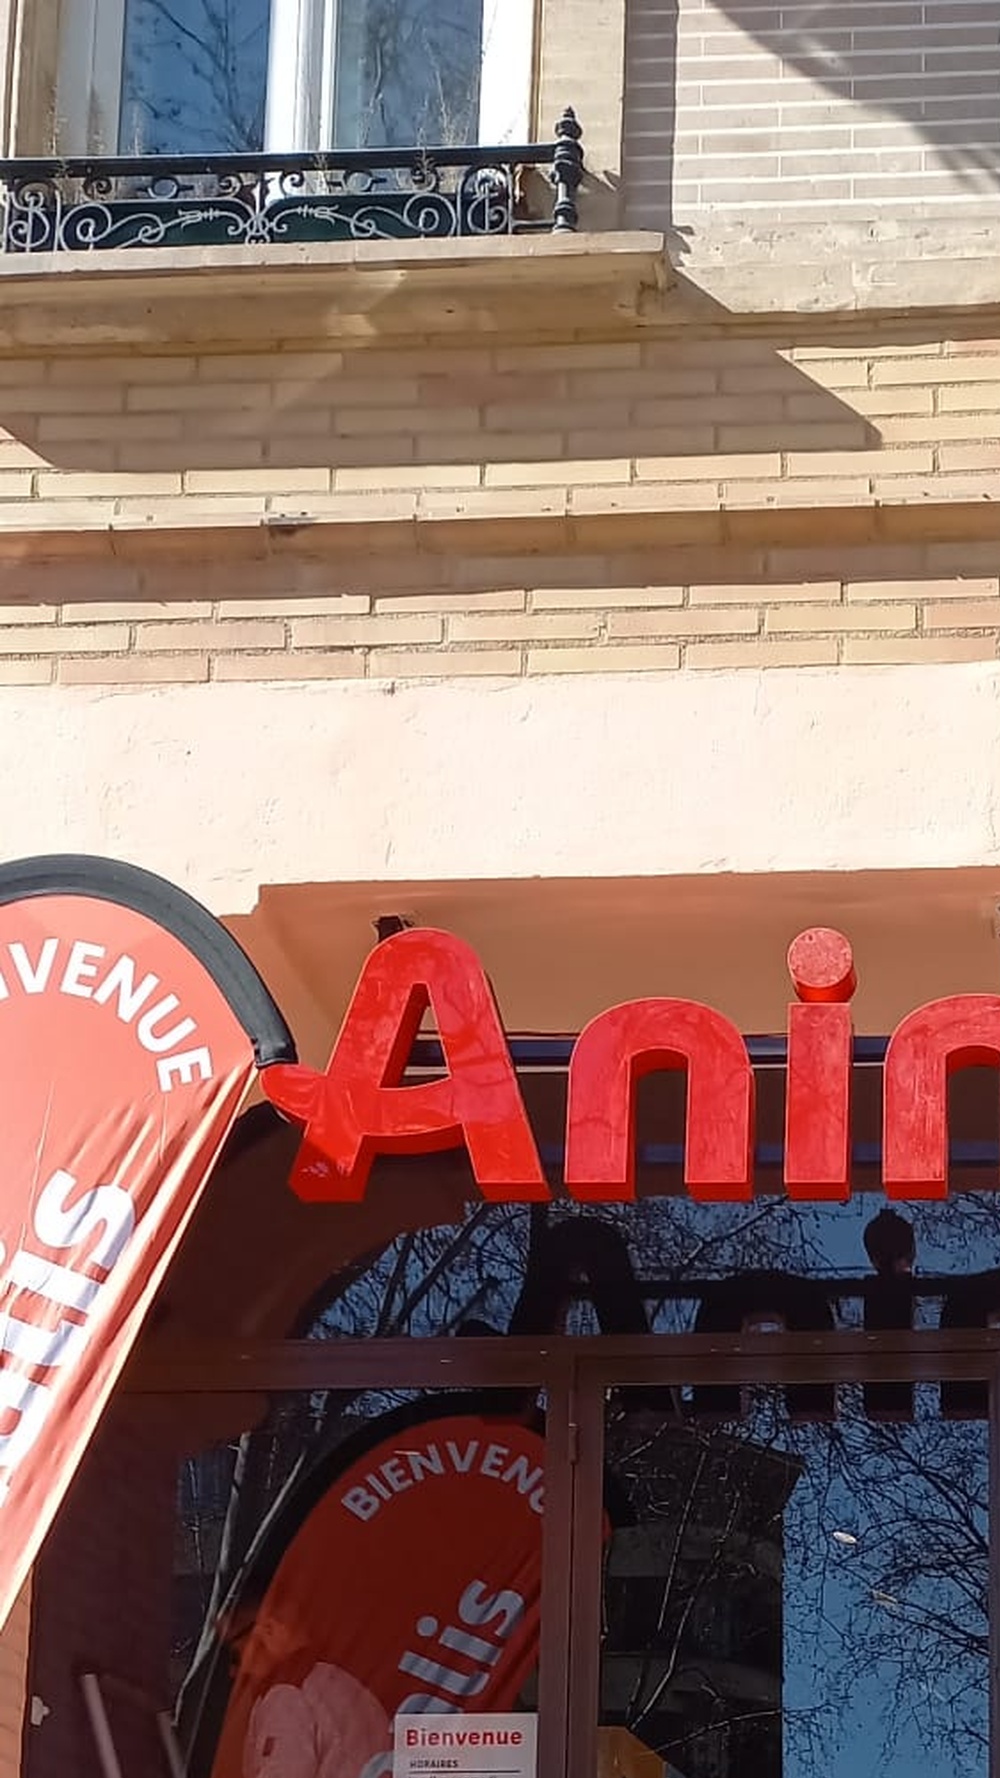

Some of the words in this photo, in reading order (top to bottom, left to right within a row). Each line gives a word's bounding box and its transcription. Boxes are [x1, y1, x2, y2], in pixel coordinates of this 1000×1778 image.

[0, 937, 214, 1092] VENUE
[341, 1440, 544, 1521] BIENVENU
[406, 1728, 523, 1747] Bienvenue
[410, 1759, 459, 1769] HORAIRES
